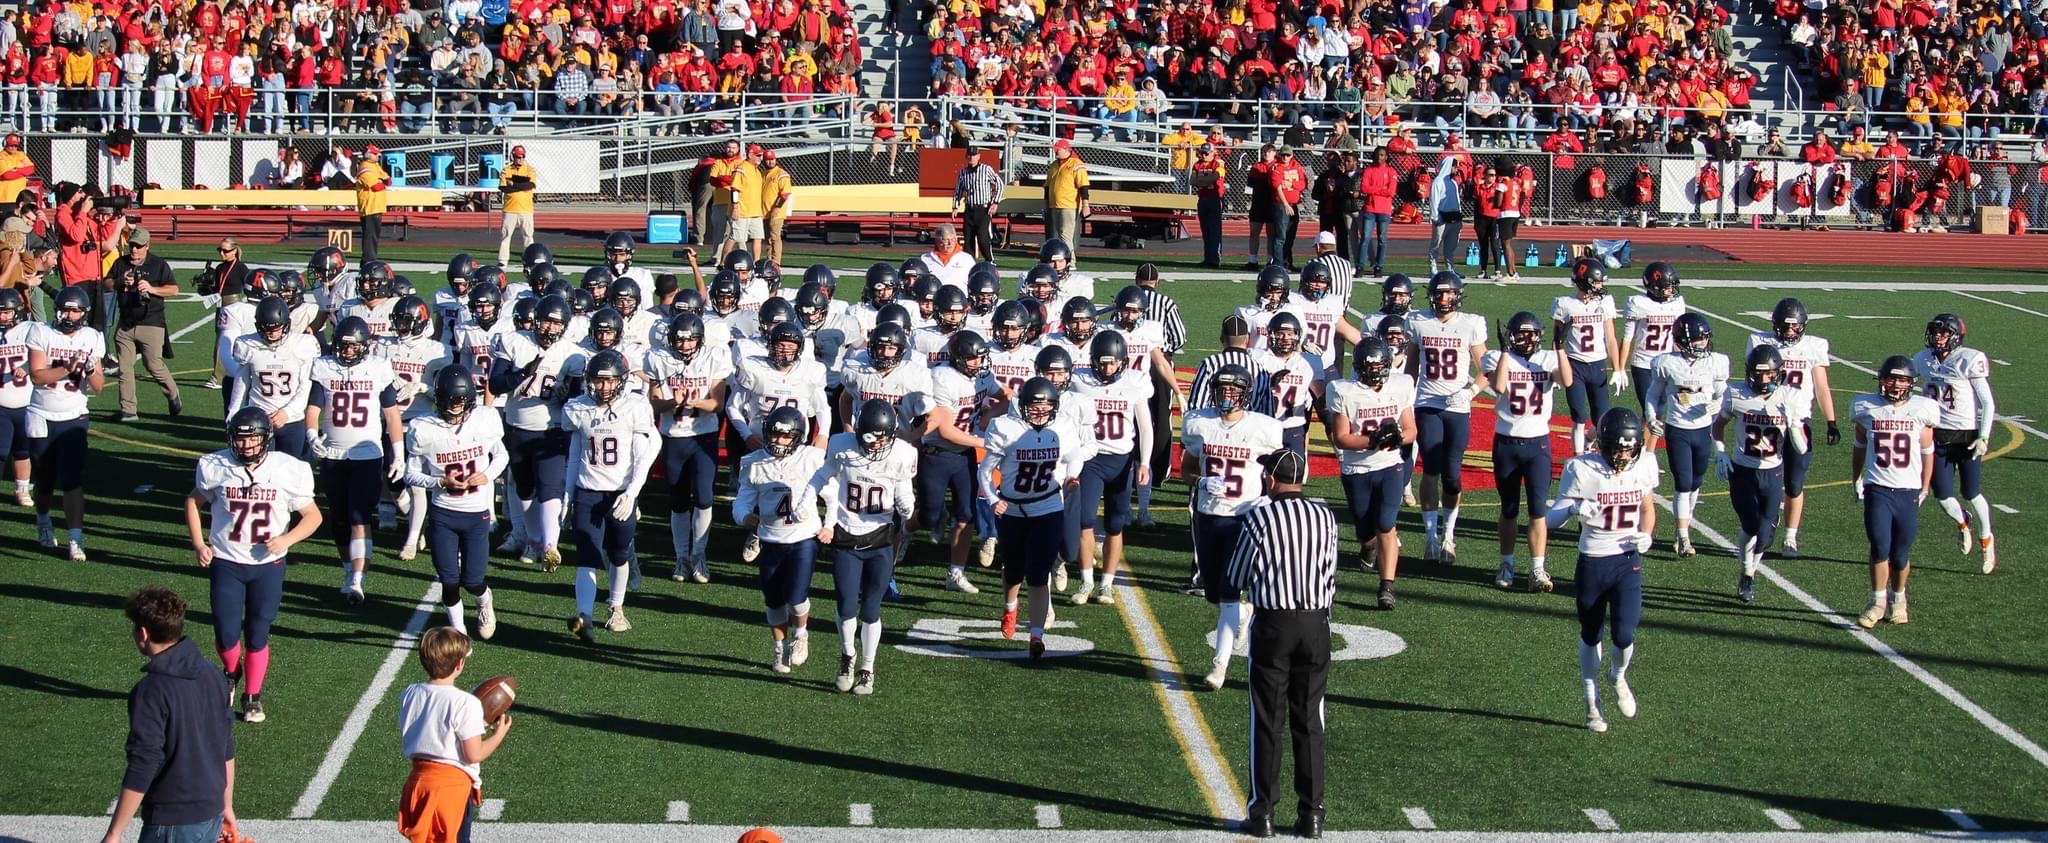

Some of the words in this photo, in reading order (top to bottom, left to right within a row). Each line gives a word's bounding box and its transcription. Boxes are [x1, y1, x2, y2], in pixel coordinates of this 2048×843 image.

[1422, 336, 1462, 347] ROCHESTER
[1580, 325, 1594, 352] 2
[1646, 325, 1671, 351] 27
[1425, 348, 1458, 381] 88
[1509, 371, 1549, 382] ROCHESTER
[258, 372, 291, 397] 53
[330, 379, 373, 391] ROCHESTER
[332, 392, 370, 428] 85
[1510, 382, 1543, 416] 54
[1358, 405, 1398, 419] ROCHESTER
[1743, 413, 1784, 425] ROCHESTER
[1872, 420, 1913, 431] ROCHESTER
[436, 446, 484, 464] ROCHESTER
[589, 436, 618, 466] 18
[1202, 444, 1251, 459] ROCHESTER
[1873, 433, 1911, 468] 59
[1014, 461, 1057, 494] 86
[226, 486, 277, 501] ROCHESTER
[848, 483, 884, 515] 80
[228, 500, 272, 544] 72
